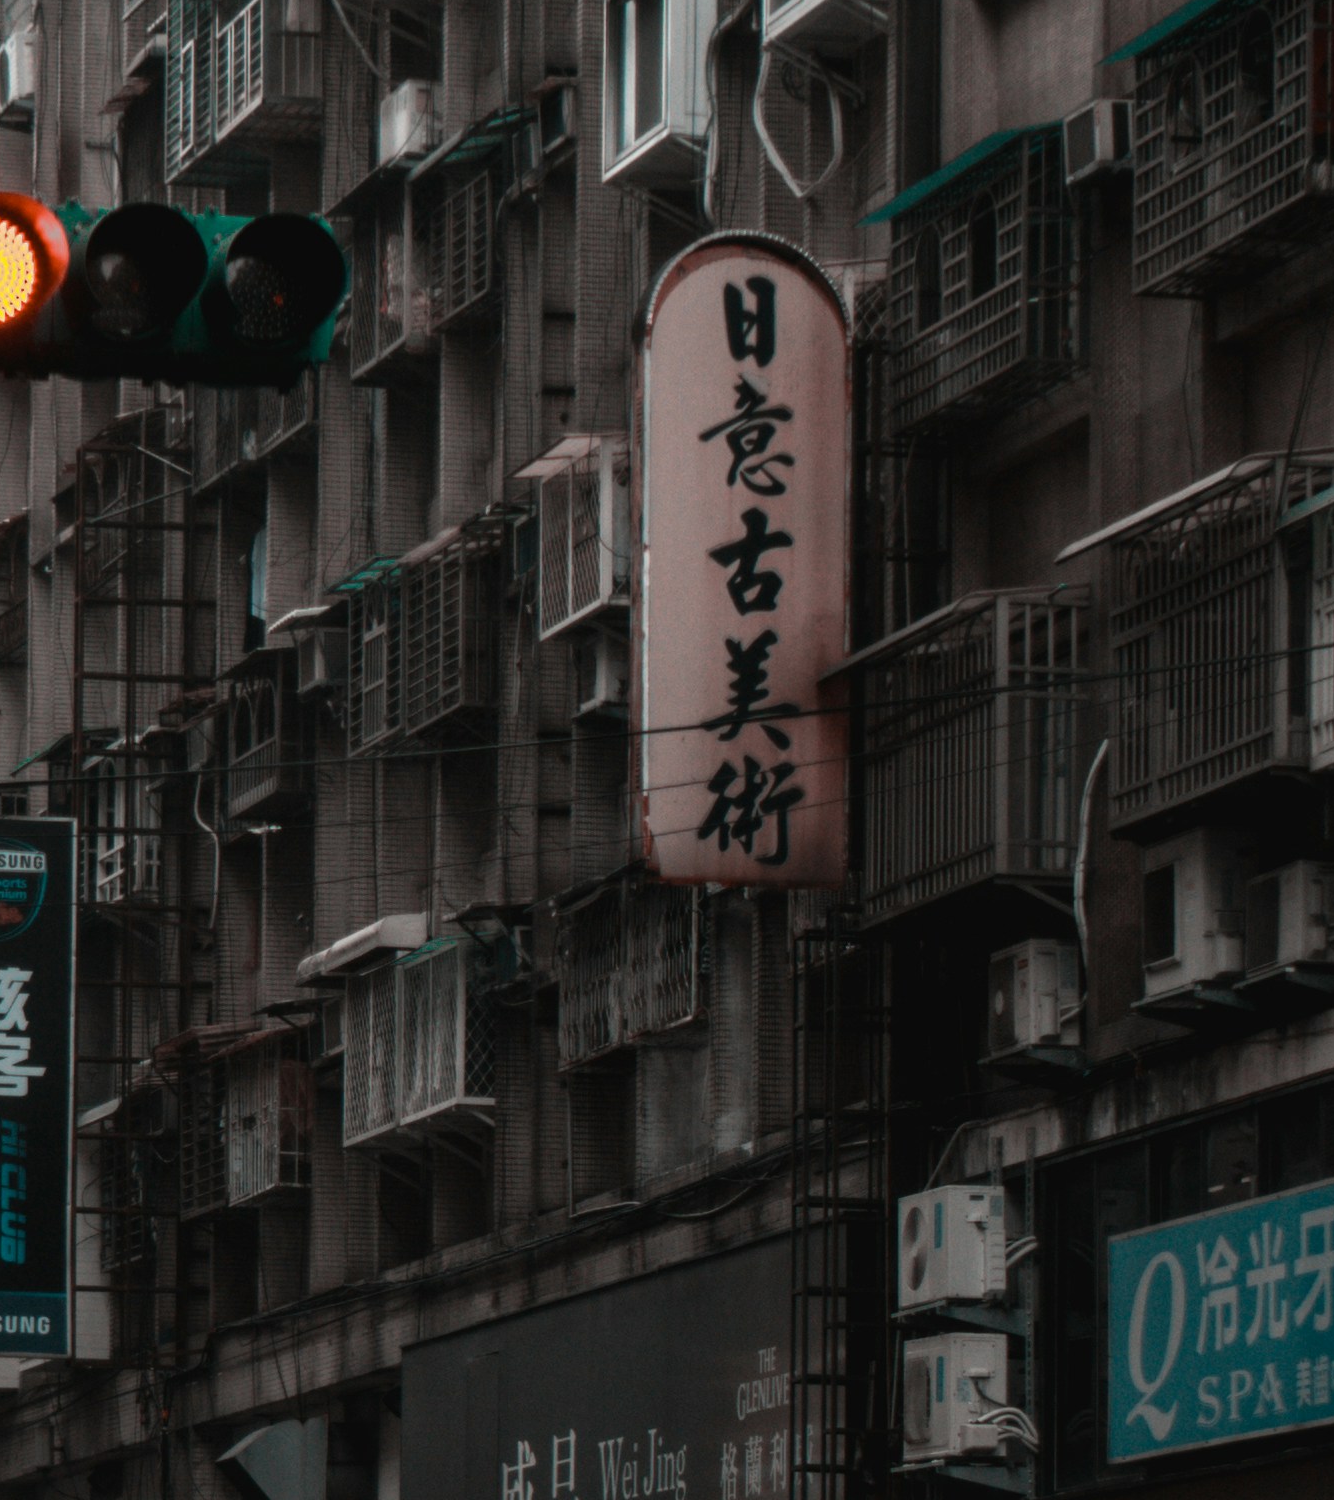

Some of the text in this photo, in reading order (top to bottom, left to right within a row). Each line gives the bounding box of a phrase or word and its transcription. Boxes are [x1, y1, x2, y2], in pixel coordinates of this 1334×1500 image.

[698, 276, 806, 866] 日意古美術
[757, 1346, 778, 1375] THE
[1125, 1250, 1187, 1441] Q
[736, 1372, 791, 1421] GLENLIVE
[1196, 1363, 1290, 1427] SPA
